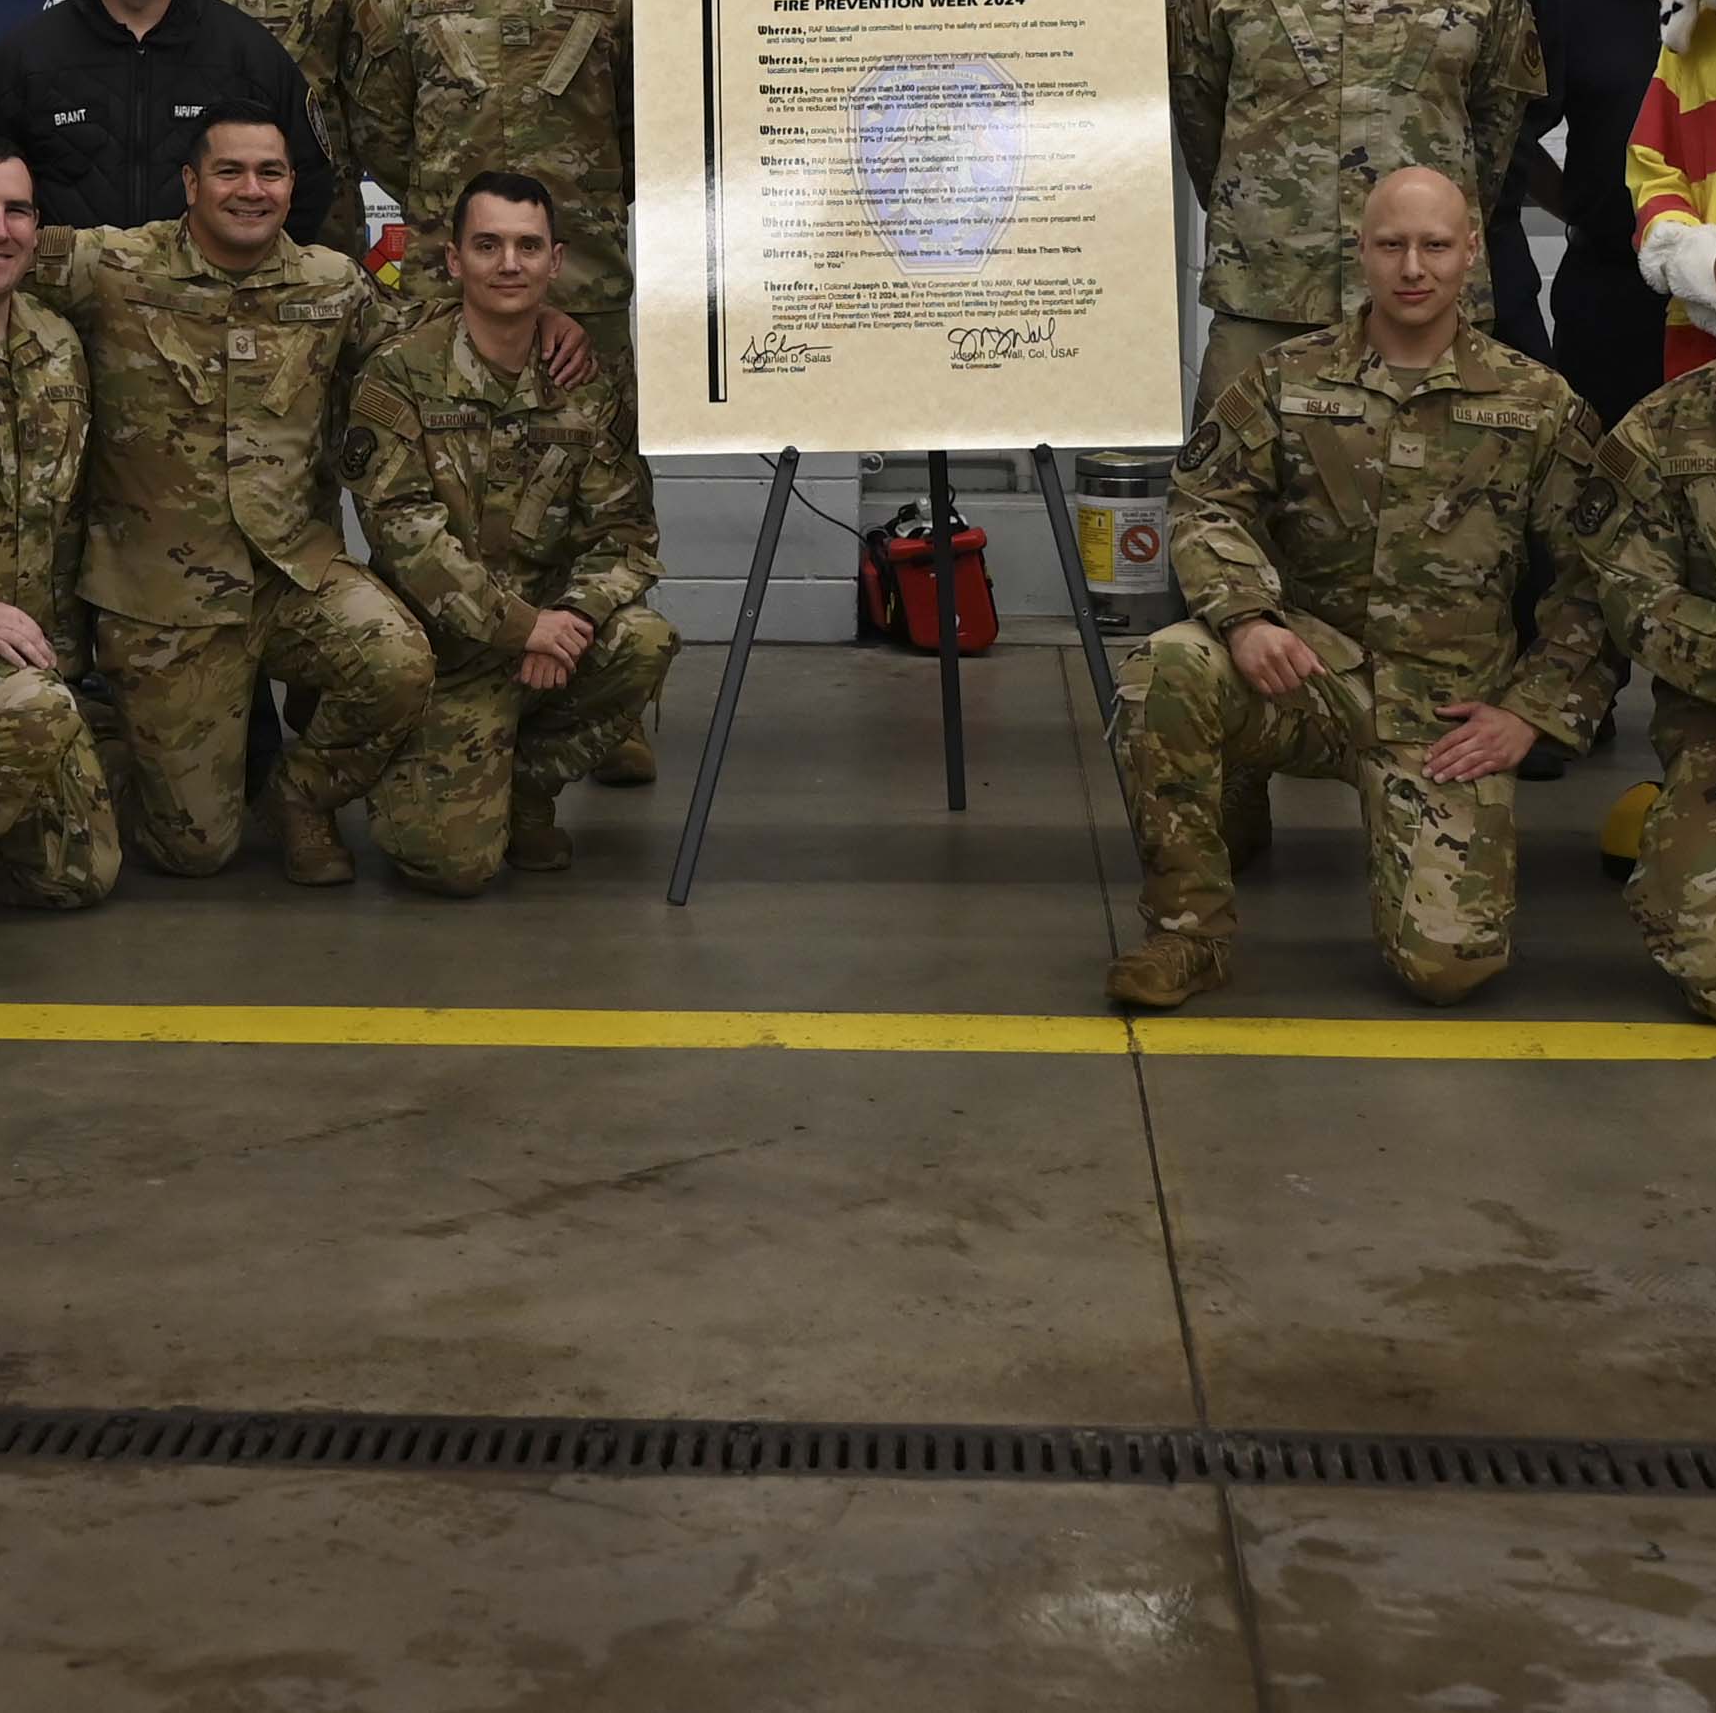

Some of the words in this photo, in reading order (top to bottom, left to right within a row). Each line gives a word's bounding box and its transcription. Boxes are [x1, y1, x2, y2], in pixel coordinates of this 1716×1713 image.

[774, 0, 809, 11] FIRE
[758, 25, 806, 36] Whereas,
[759, 55, 807, 65] Whereas,
[759, 84, 808, 95] Whereas,
[54, 109, 86, 125] BRANT
[759, 125, 809, 136] Whereas,
[761, 156, 810, 166] Whereas,
[763, 249, 812, 259] Whereas,
[764, 281, 819, 292] Therefore,
[791, 353, 801, 363] D.
[804, 352, 832, 363] Salas
[1051, 348, 1080, 358] USAF
[1306, 399, 1341, 414] ISLAS
[1476, 412, 1495, 424] AIR
[1496, 413, 1532, 428] FORCE
